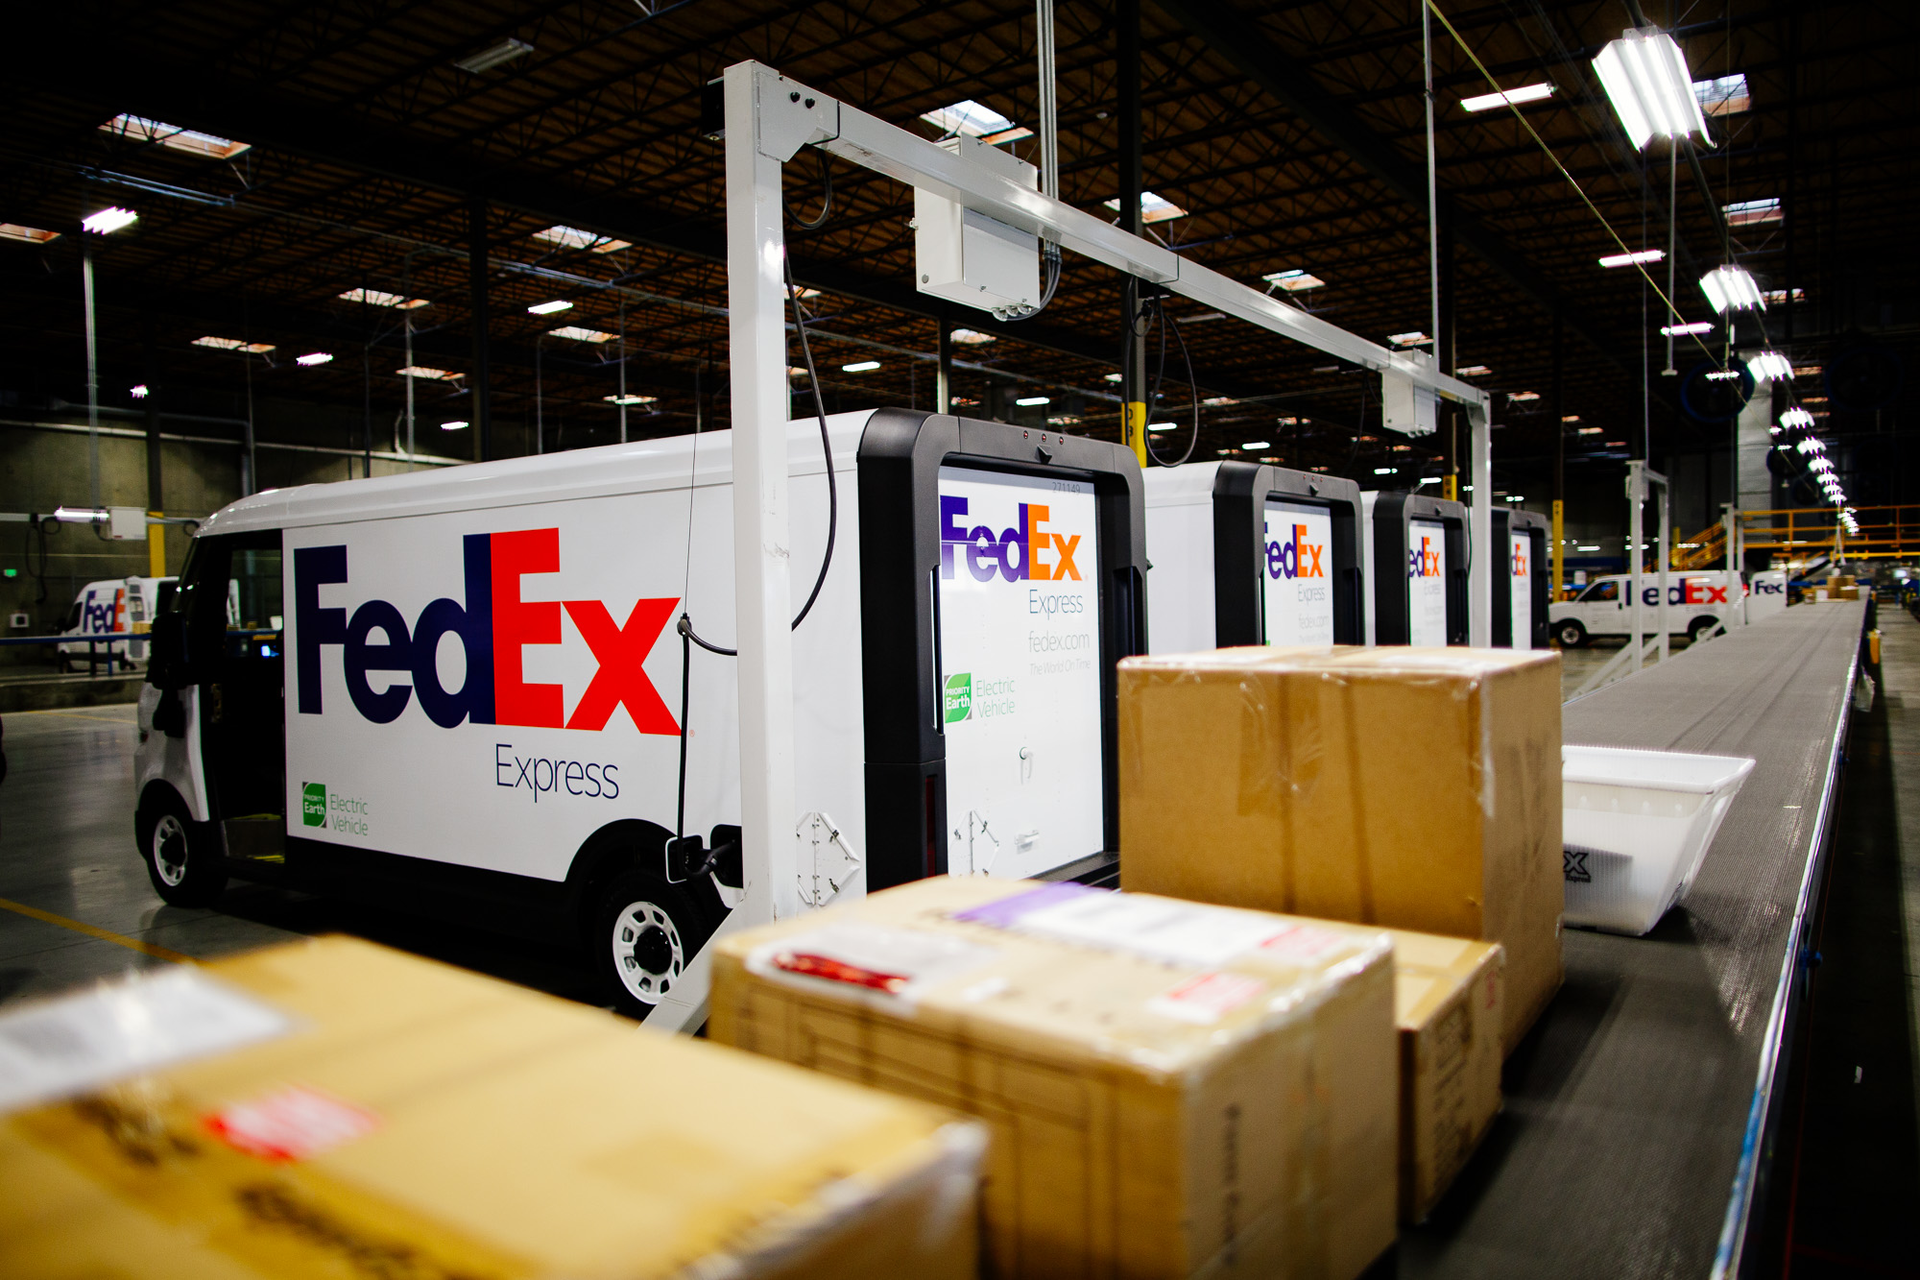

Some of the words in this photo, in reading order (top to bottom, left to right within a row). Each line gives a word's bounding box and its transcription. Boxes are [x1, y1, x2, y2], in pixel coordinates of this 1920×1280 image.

[1052, 481, 1081, 495] 271149
[940, 495, 1083, 583] FedEx
[1263, 522, 1324, 580] edEx
[1409, 536, 1440, 578] edEx
[1511, 543, 1527, 576] dEx
[83, 588, 126, 634] FedE
[1029, 589, 1084, 620] Express
[294, 527, 682, 736] FedEx
[1028, 630, 1091, 653] fedex.com
[945, 686, 971, 696] PRIORITY
[976, 676, 1016, 698] Electric
[945, 695, 971, 710] Earth
[977, 698, 1016, 718] Vehicle
[496, 743, 620, 803] Express
[304, 802, 325, 816] Earth
[330, 793, 368, 816] Electric
[331, 814, 369, 837] Vehicle
